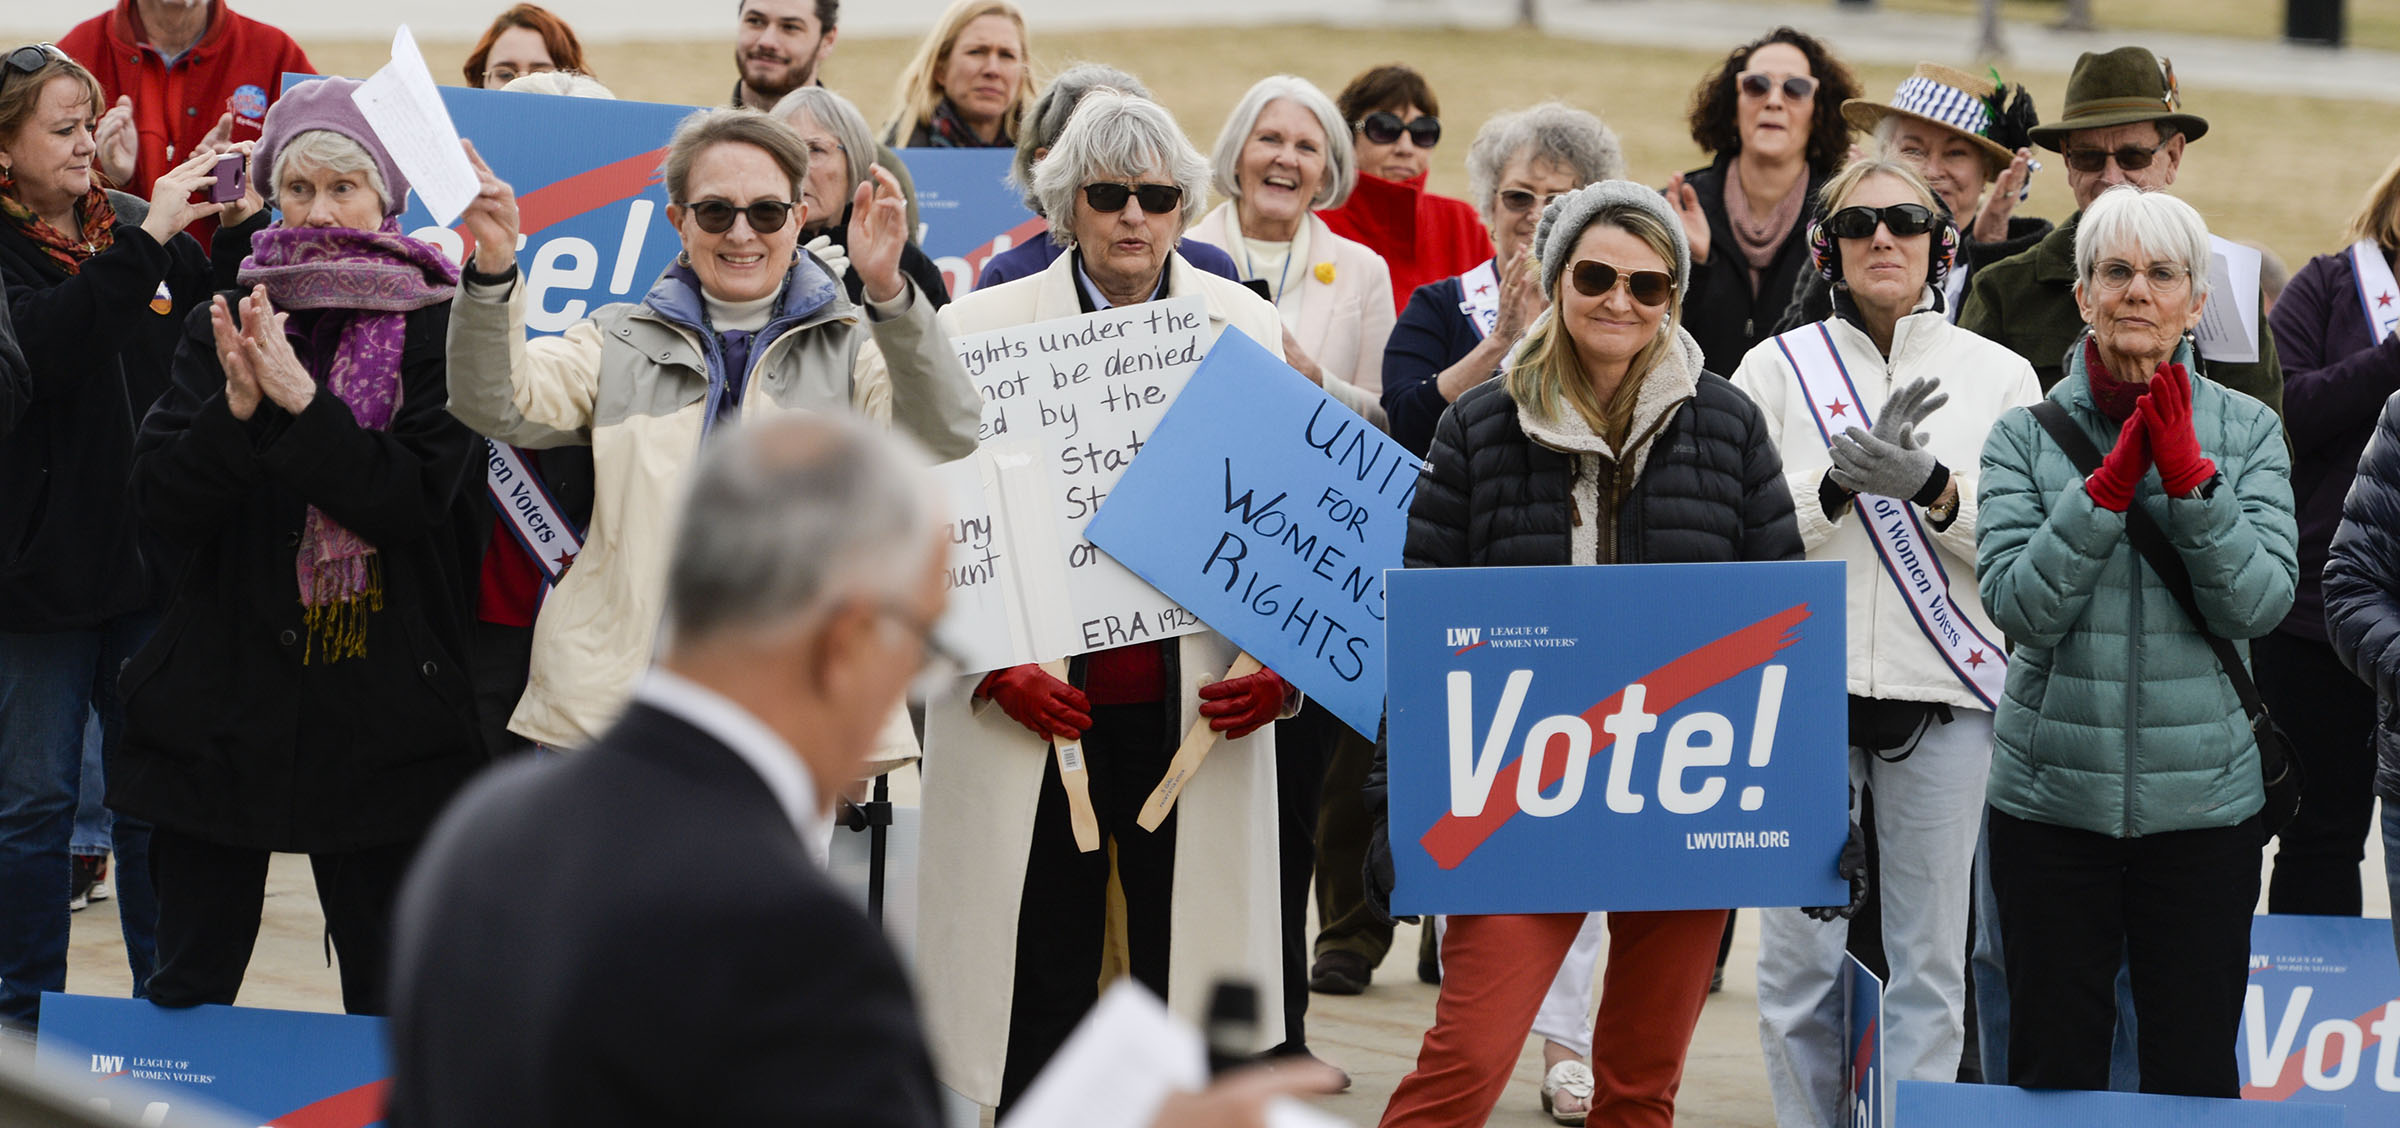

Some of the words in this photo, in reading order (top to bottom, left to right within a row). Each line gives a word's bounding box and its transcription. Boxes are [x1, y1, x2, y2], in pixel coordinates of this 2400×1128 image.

[959, 336, 1028, 376] ights
[1039, 320, 1133, 352] under
[1143, 307, 1200, 335] the
[1050, 362, 1091, 390] be
[1104, 335, 1203, 377] denied
[979, 406, 1007, 441] ed
[1039, 399, 1079, 440] by
[1100, 384, 1166, 412] the
[1061, 430, 1144, 475] Stat
[1305, 399, 1421, 510] UNIT
[510, 481, 556, 543] Voters
[1066, 485, 1106, 519] St
[1316, 486, 1369, 543] FOR
[1874, 499, 1900, 520] of
[1887, 520, 1932, 594] Women
[1928, 594, 1961, 647] Voters
[1082, 612, 1149, 649] ERA
[1202, 531, 1369, 682] RIGHTS
[1447, 628, 1480, 646] LWV
[1490, 627, 1532, 636] LEAGUE
[1535, 626, 1549, 635] OF
[1490, 639, 1532, 648] WOMEN
[1447, 665, 1788, 817] Vote!
[1686, 831, 1790, 849] LWVUTAH.ORG
[2249, 955, 2269, 968] WV
[90, 1054, 125, 1073] LWV
[132, 1057, 173, 1069] LEAGUE
[175, 1060, 190, 1070] OF
[132, 1069, 171, 1081] WOMEN
